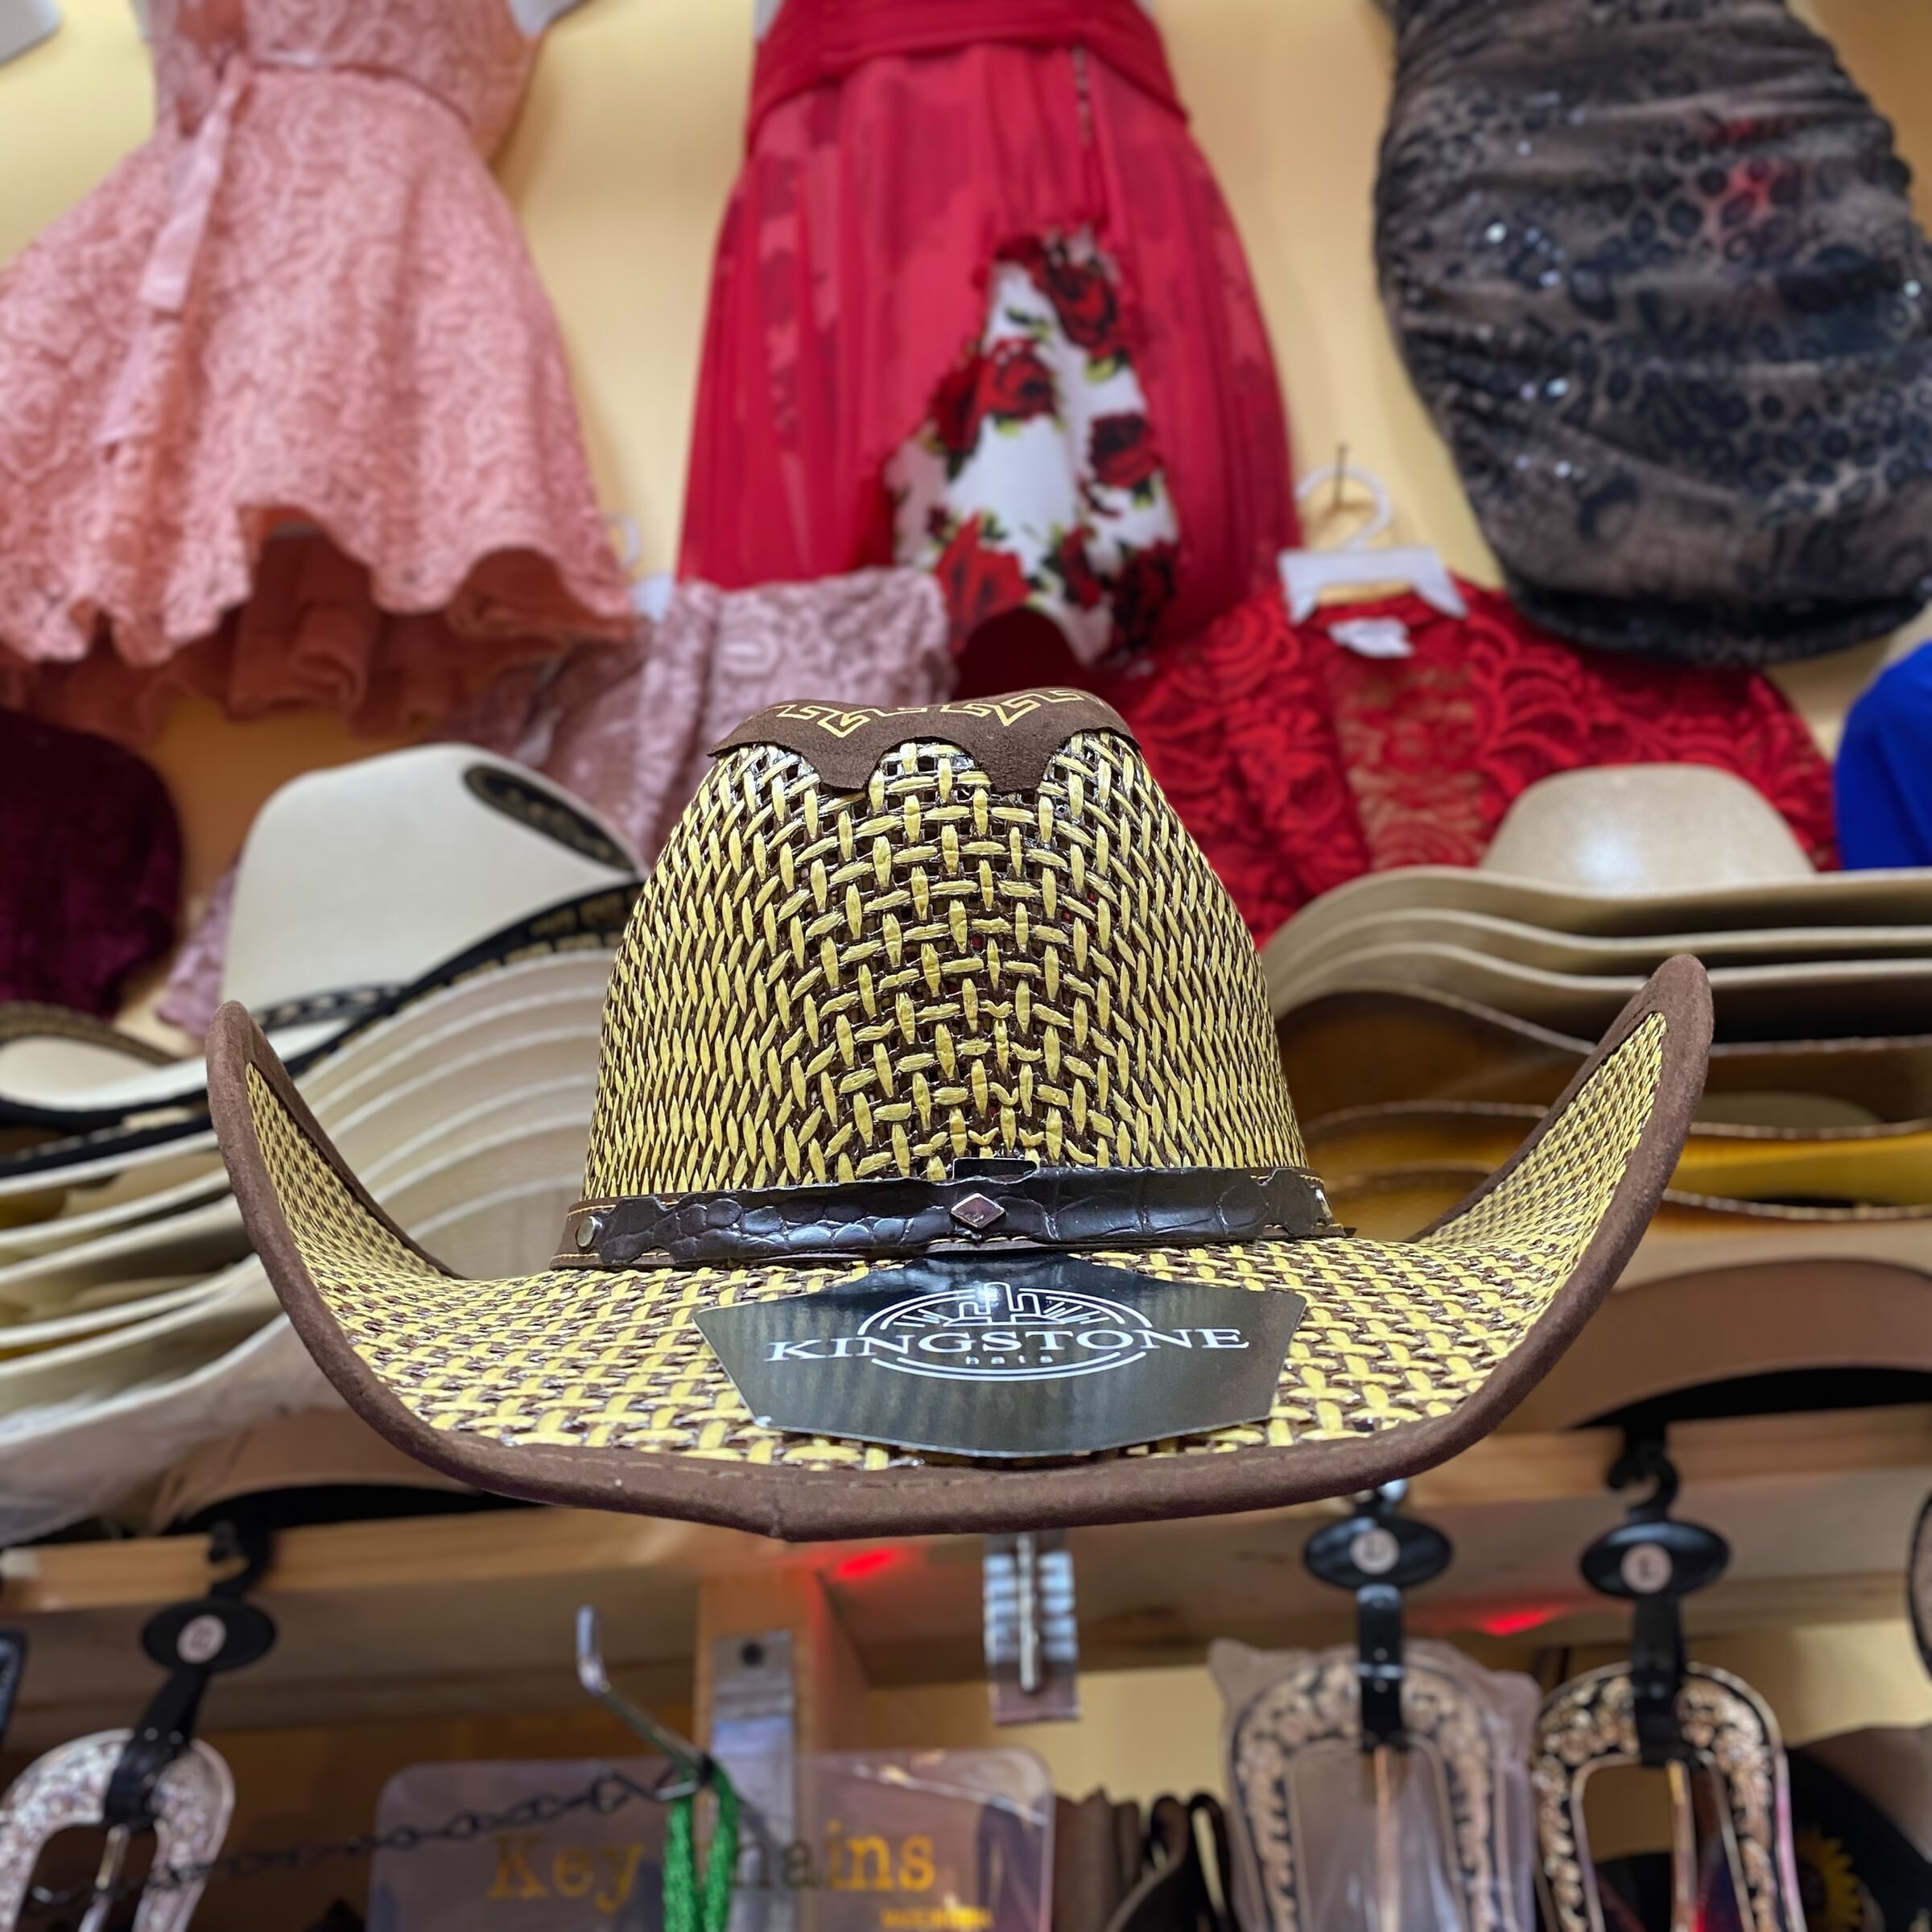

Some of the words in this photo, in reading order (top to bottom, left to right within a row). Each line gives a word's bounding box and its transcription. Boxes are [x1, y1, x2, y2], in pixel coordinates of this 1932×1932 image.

[765, 1328, 1250, 1361] KINGSTONE
[486, 1833, 646, 1915] Key
[694, 1819, 936, 1891] hains
